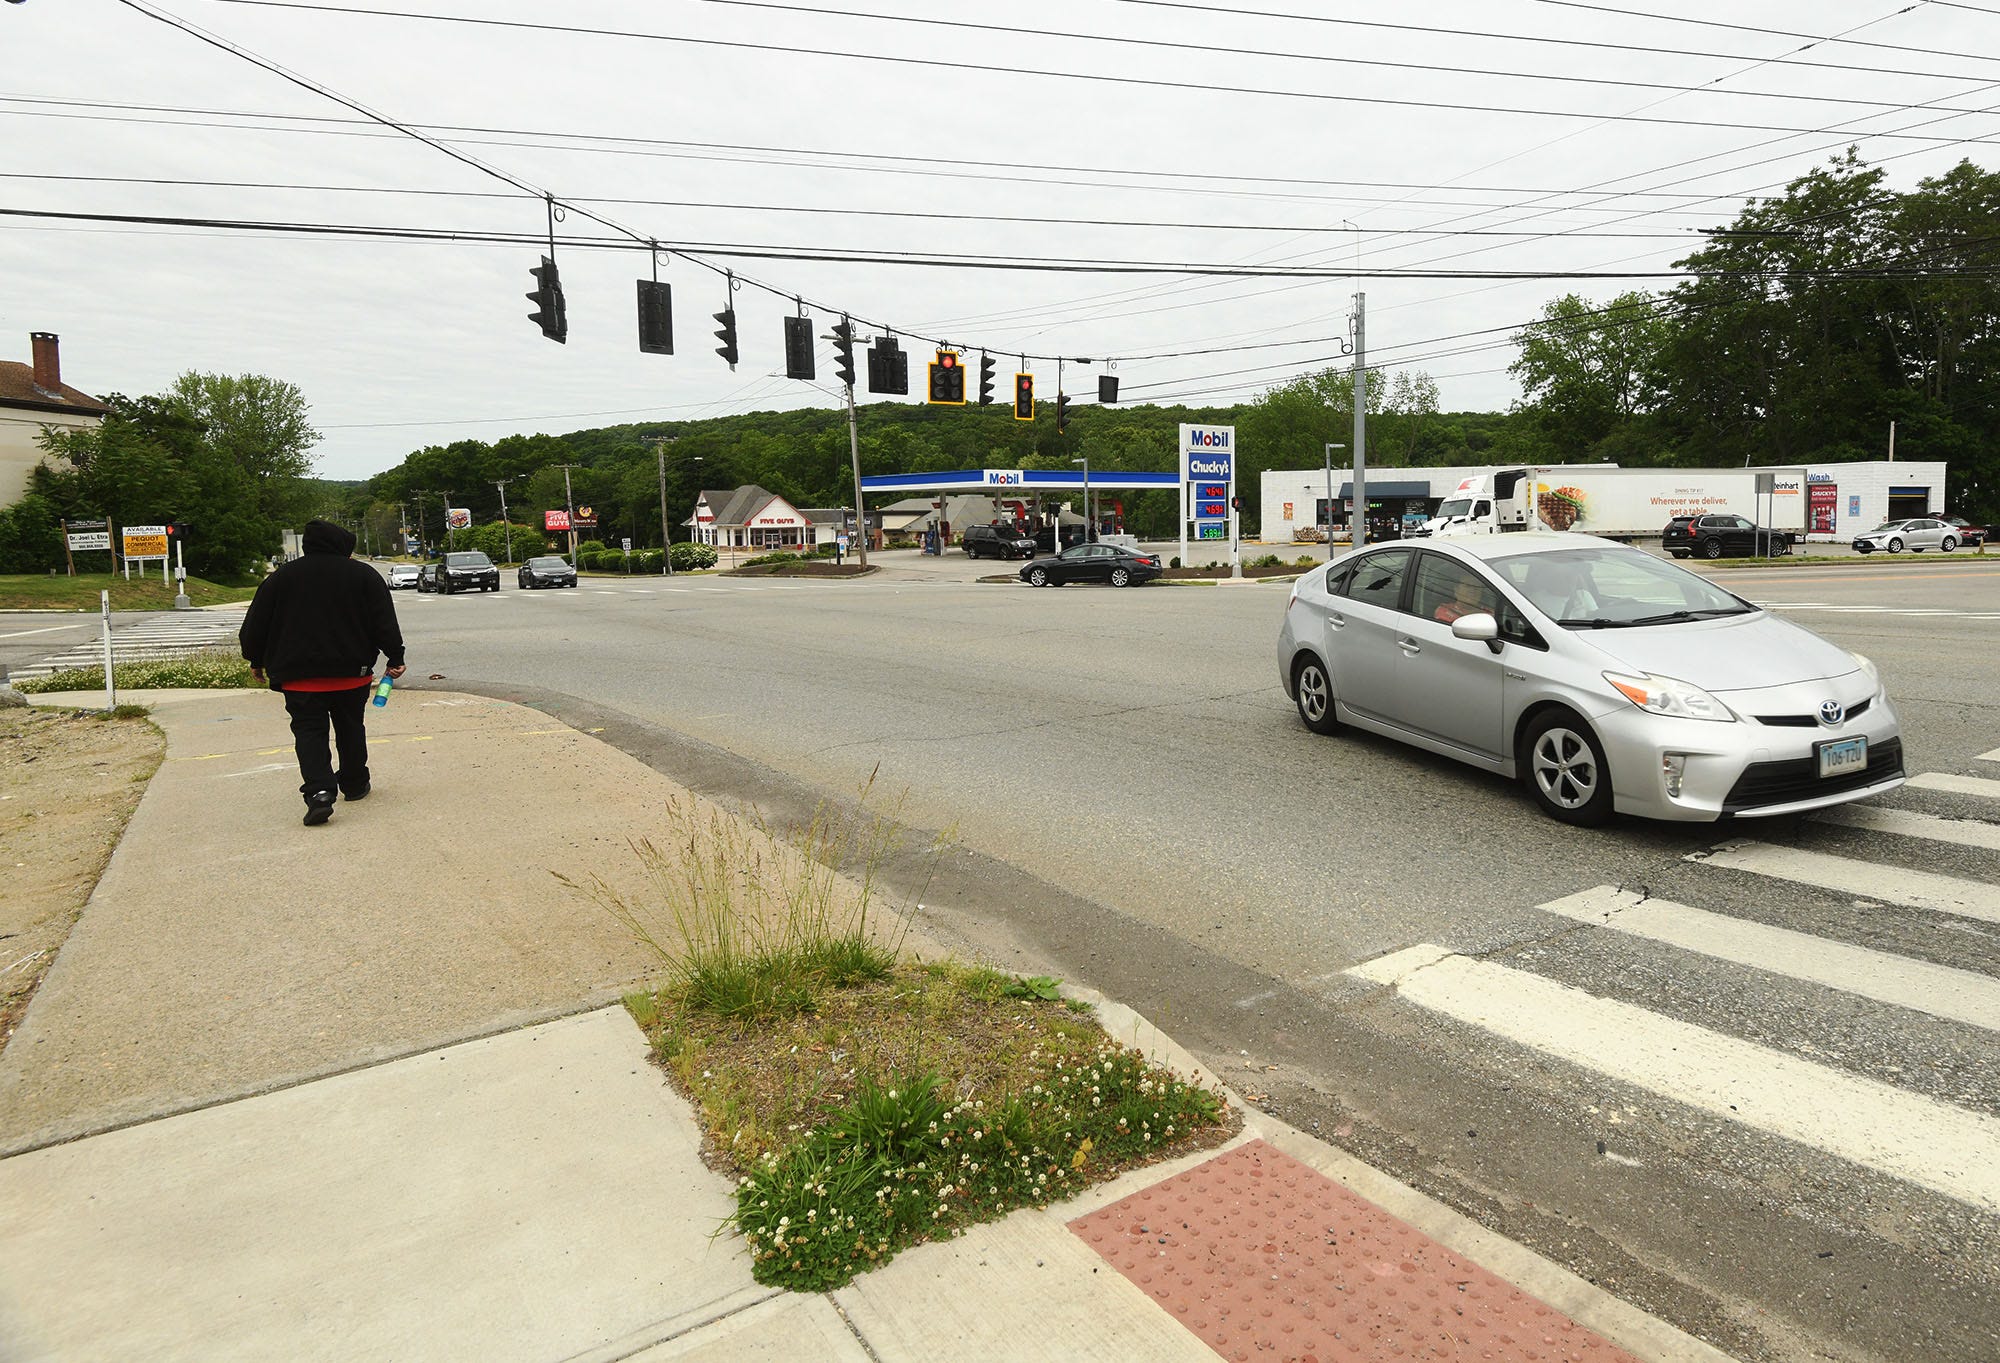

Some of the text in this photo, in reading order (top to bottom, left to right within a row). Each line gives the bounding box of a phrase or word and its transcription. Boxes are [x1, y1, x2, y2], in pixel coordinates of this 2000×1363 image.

[1191, 430, 1229, 447] Mobil
[1190, 460, 1229, 476] Chucky's
[989, 473, 1019, 484] Mobil
[1808, 473, 1830, 481] Wash
[1774, 481, 1799, 489] einhart
[1650, 497, 1687, 505] Wherever
[1701, 497, 1728, 505] deliver,
[1669, 508, 1682, 517] get
